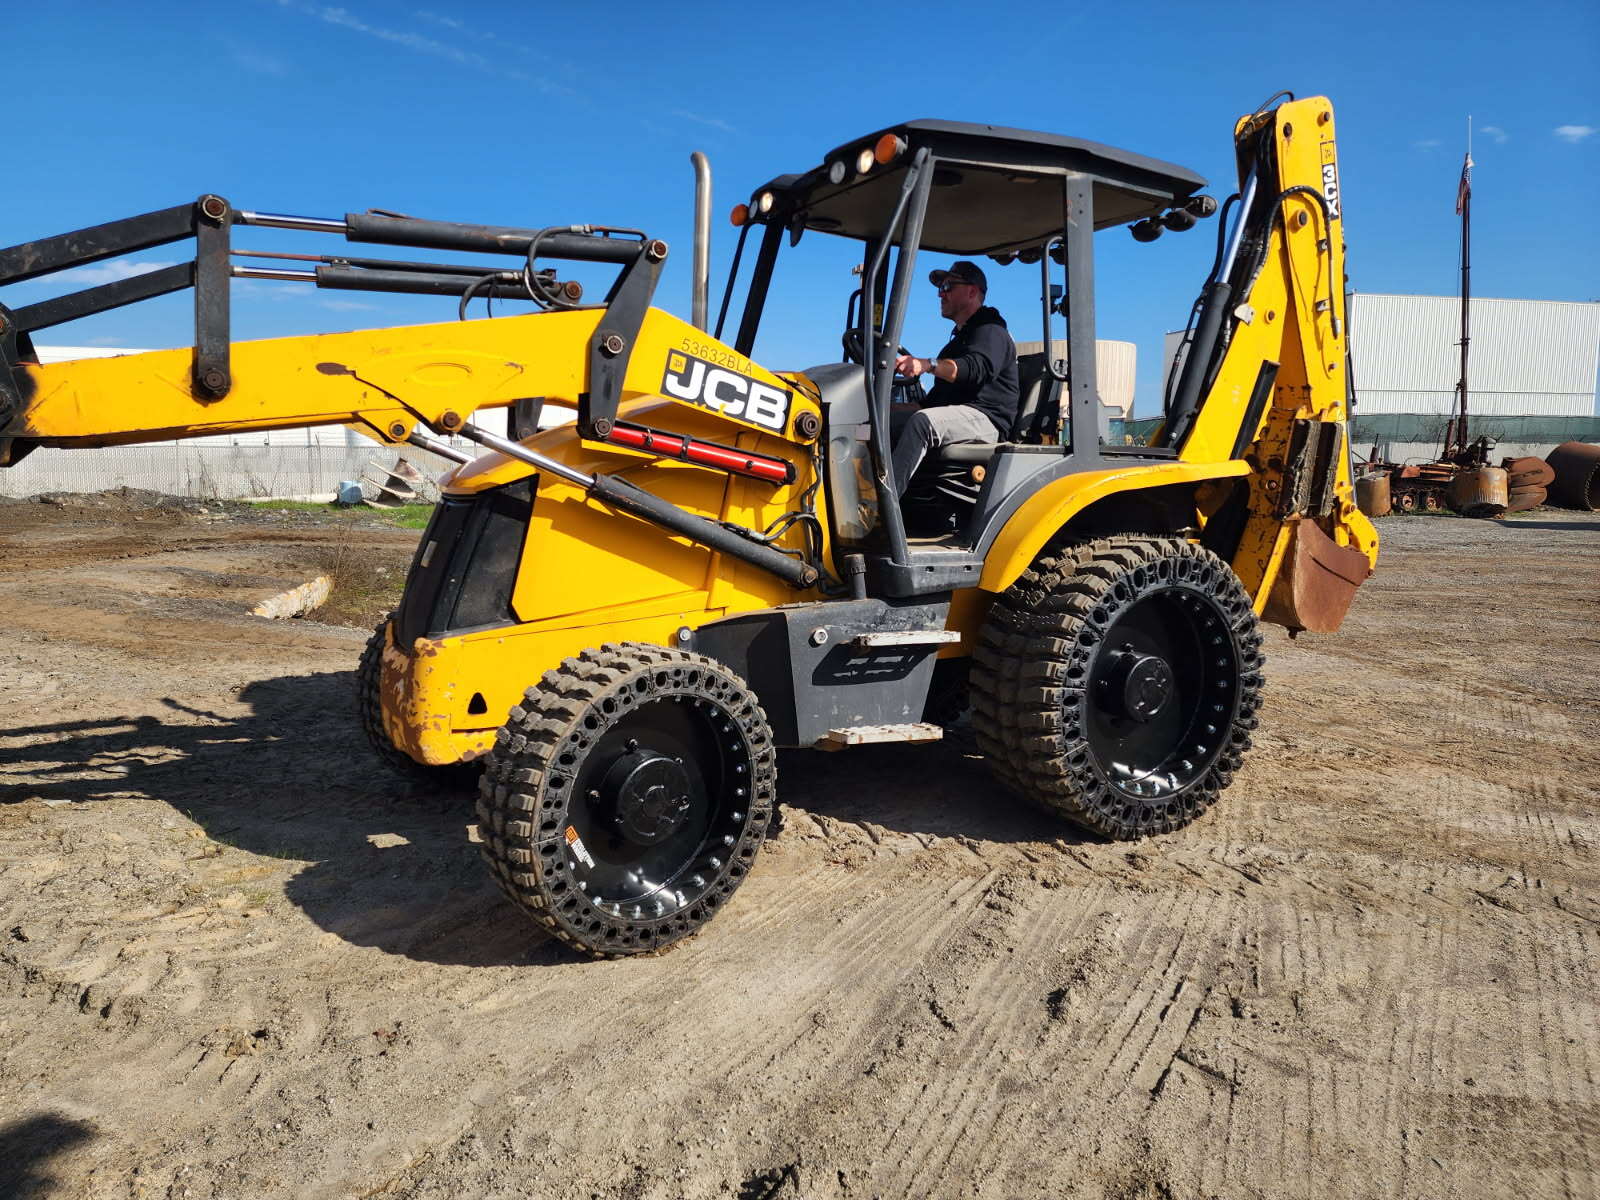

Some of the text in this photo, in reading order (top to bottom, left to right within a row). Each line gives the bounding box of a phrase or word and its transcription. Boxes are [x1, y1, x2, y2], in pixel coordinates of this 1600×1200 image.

[1324, 165, 1339, 216] 3CX
[681, 339, 753, 376] 53632BLA
[665, 361, 788, 429] JCB
